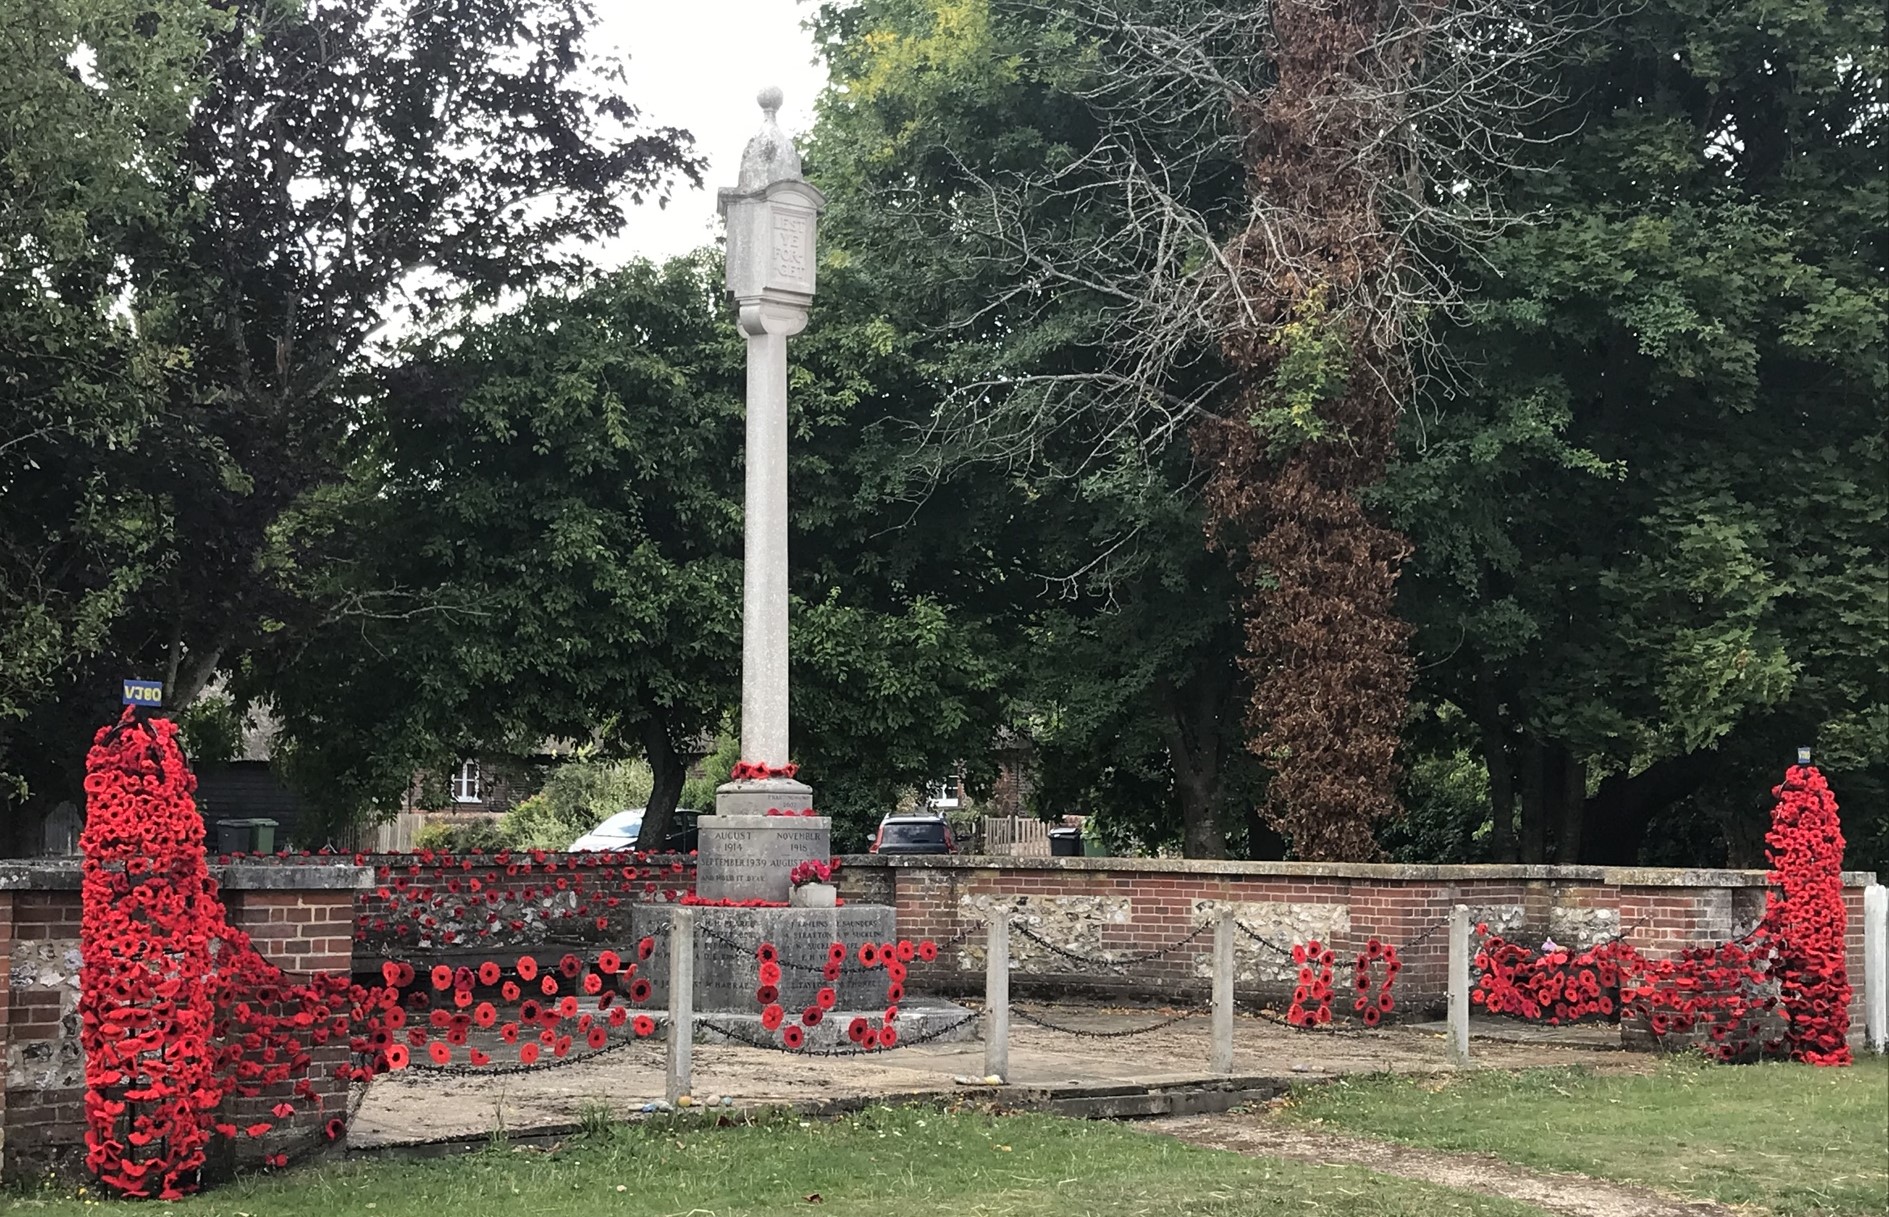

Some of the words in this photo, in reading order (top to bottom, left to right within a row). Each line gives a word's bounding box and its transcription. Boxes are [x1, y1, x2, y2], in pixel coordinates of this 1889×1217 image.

[124, 685, 162, 702] VJ80
[715, 832, 751, 840] AUGUST
[777, 832, 821, 840] NOVEMBER
[724, 844, 743, 852] 1914
[701, 859, 745, 867] SEPTEMBER
[746, 859, 767, 867] 1939
